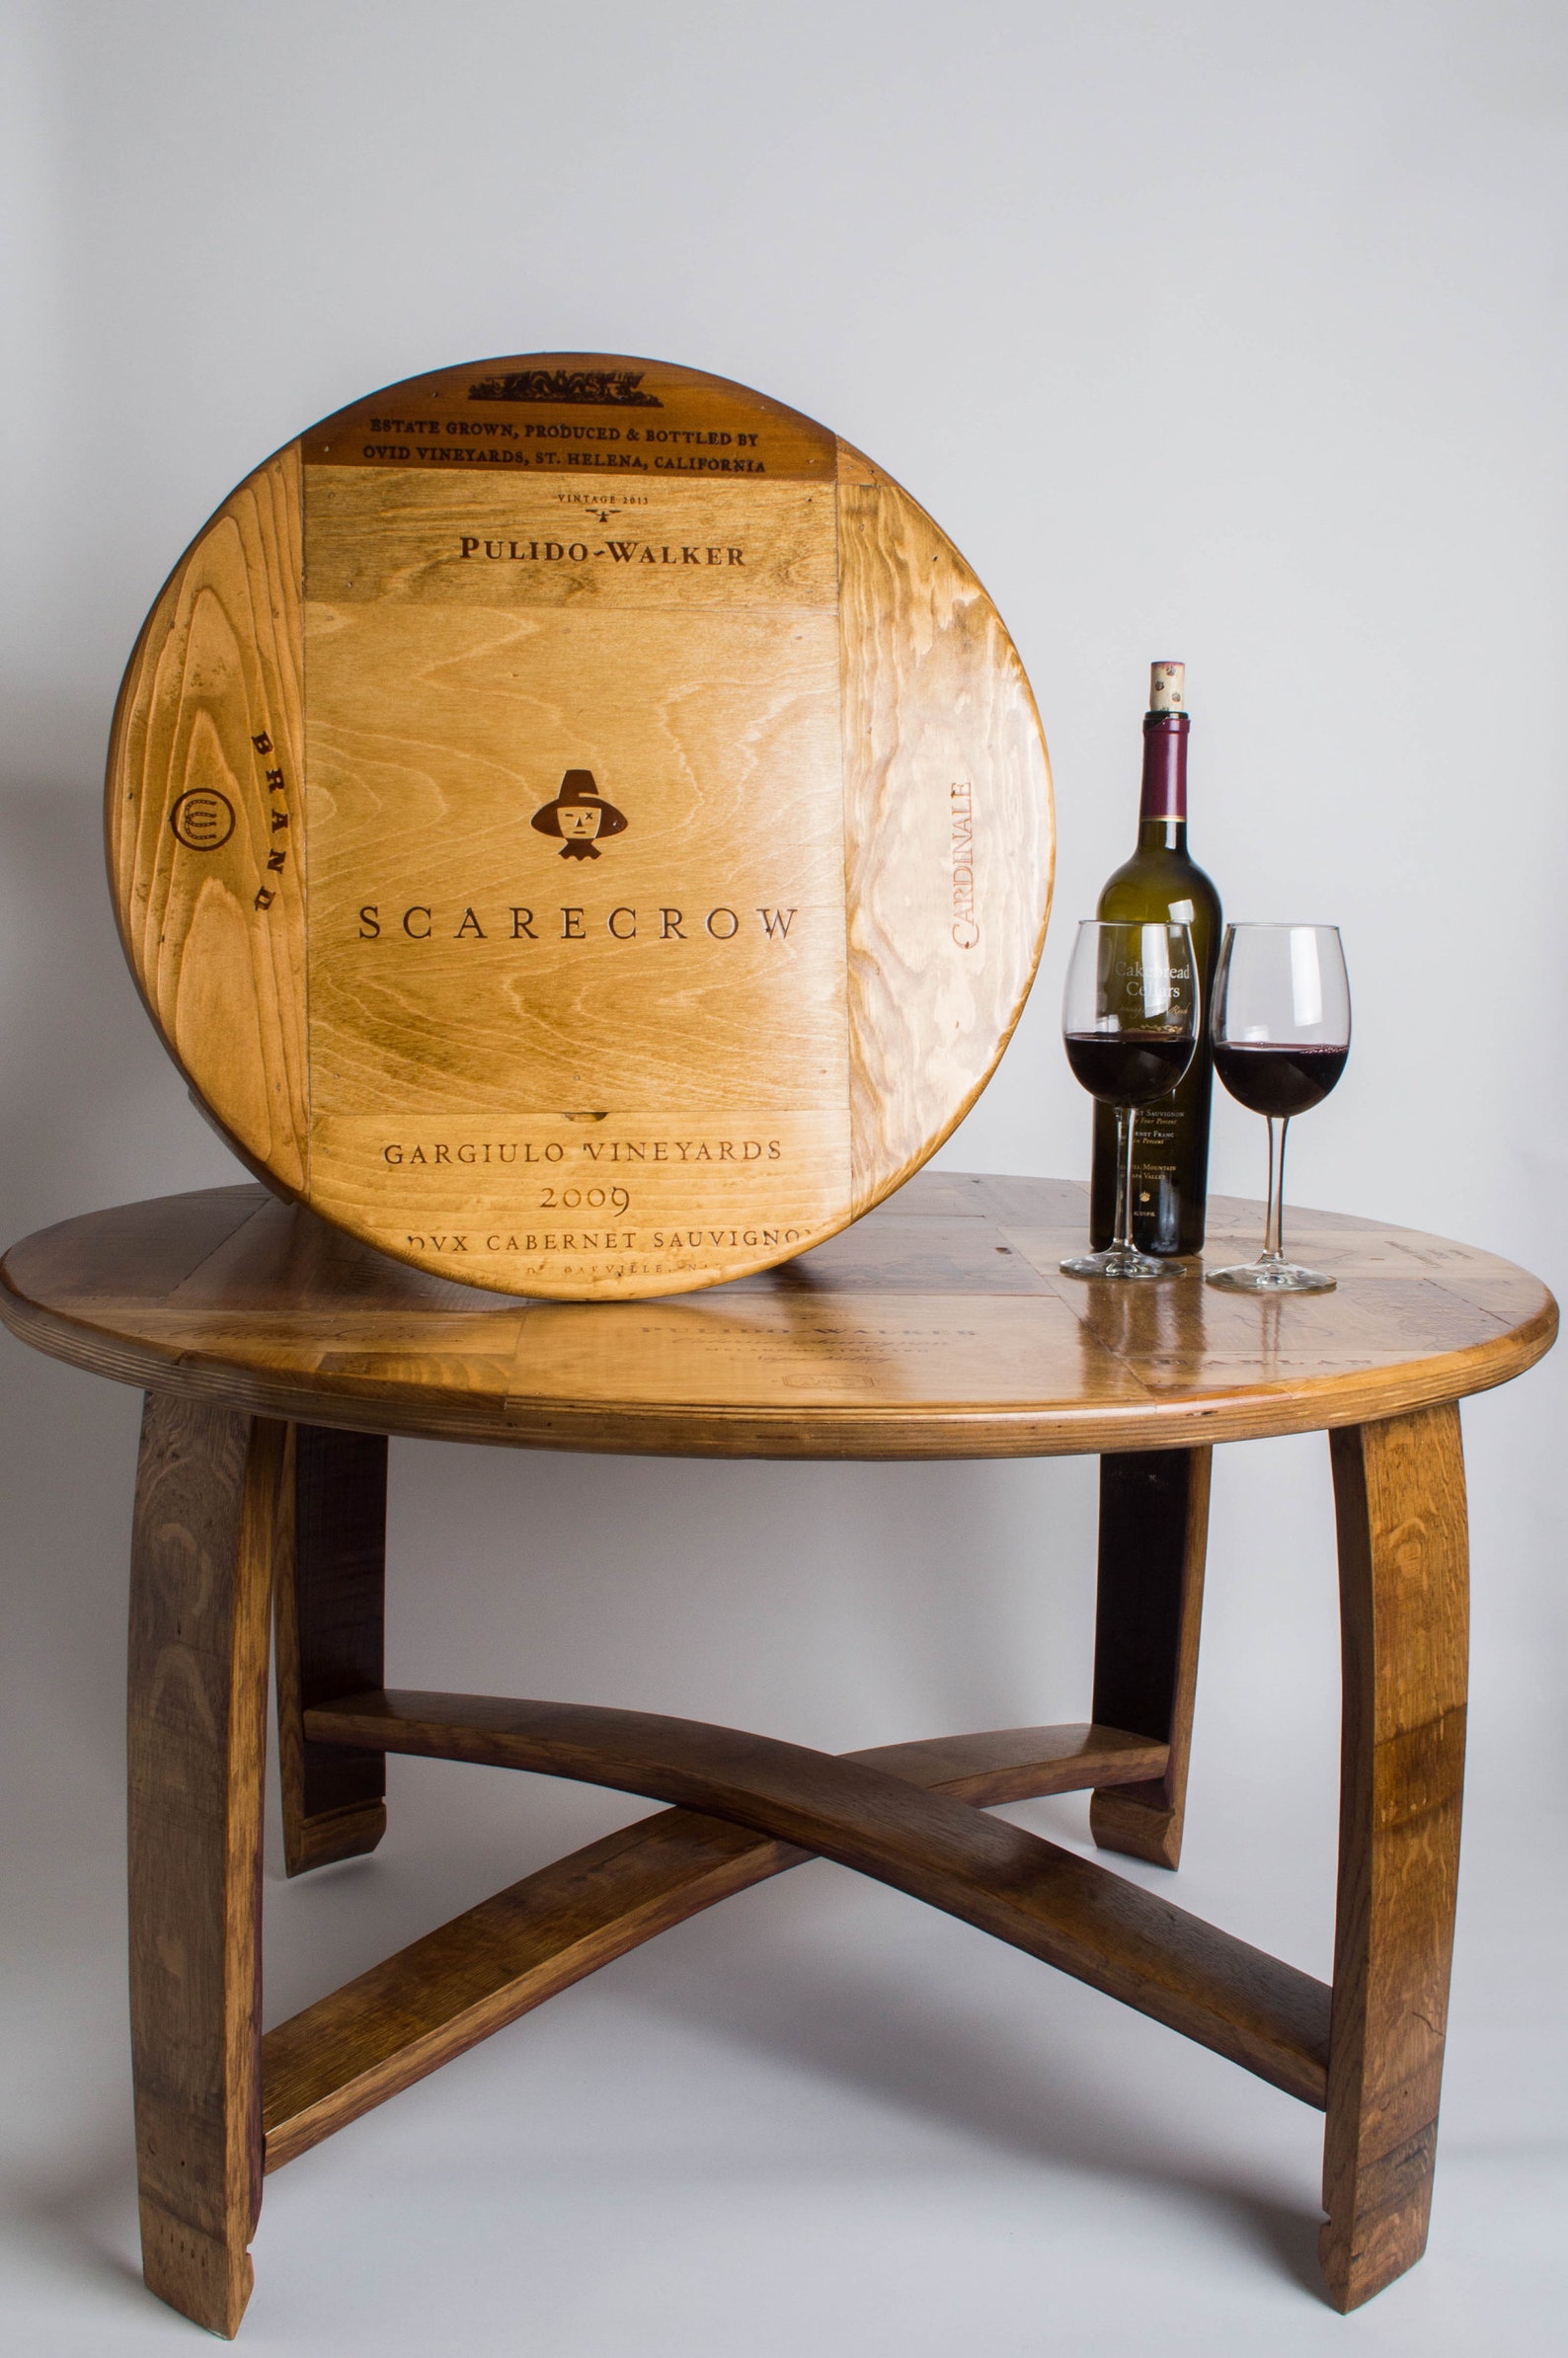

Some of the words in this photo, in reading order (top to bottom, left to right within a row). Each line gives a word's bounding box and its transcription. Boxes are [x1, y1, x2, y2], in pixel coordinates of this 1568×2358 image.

[370, 419, 440, 433] ESTATE
[445, 422, 519, 439] GROWN,
[524, 425, 621, 441] PRODUCED
[626, 429, 640, 441] &
[645, 430, 733, 446] BOTTLED
[738, 432, 759, 447] BY
[362, 445, 411, 460] OVID
[416, 447, 530, 466] VINEYARDS,
[535, 450, 562, 465] ST.
[568, 452, 649, 471] HELENA,
[654, 455, 767, 474] CALIFORNIA
[558, 494, 616, 505] VINTAGE
[459, 536, 746, 567] PULIDO-WALKER
[251, 731, 289, 912] BRAND
[951, 782, 980, 950] CARDINALE
[358, 905, 798, 940] SCARECROW
[384, 1142, 565, 1165] GARGIULO
[583, 1140, 782, 1162] VINEYARDS
[540, 1186, 631, 1218] 2009
[487, 1232, 637, 1252] CABERNET
[654, 1228, 815, 1248] SAUVIGNO
